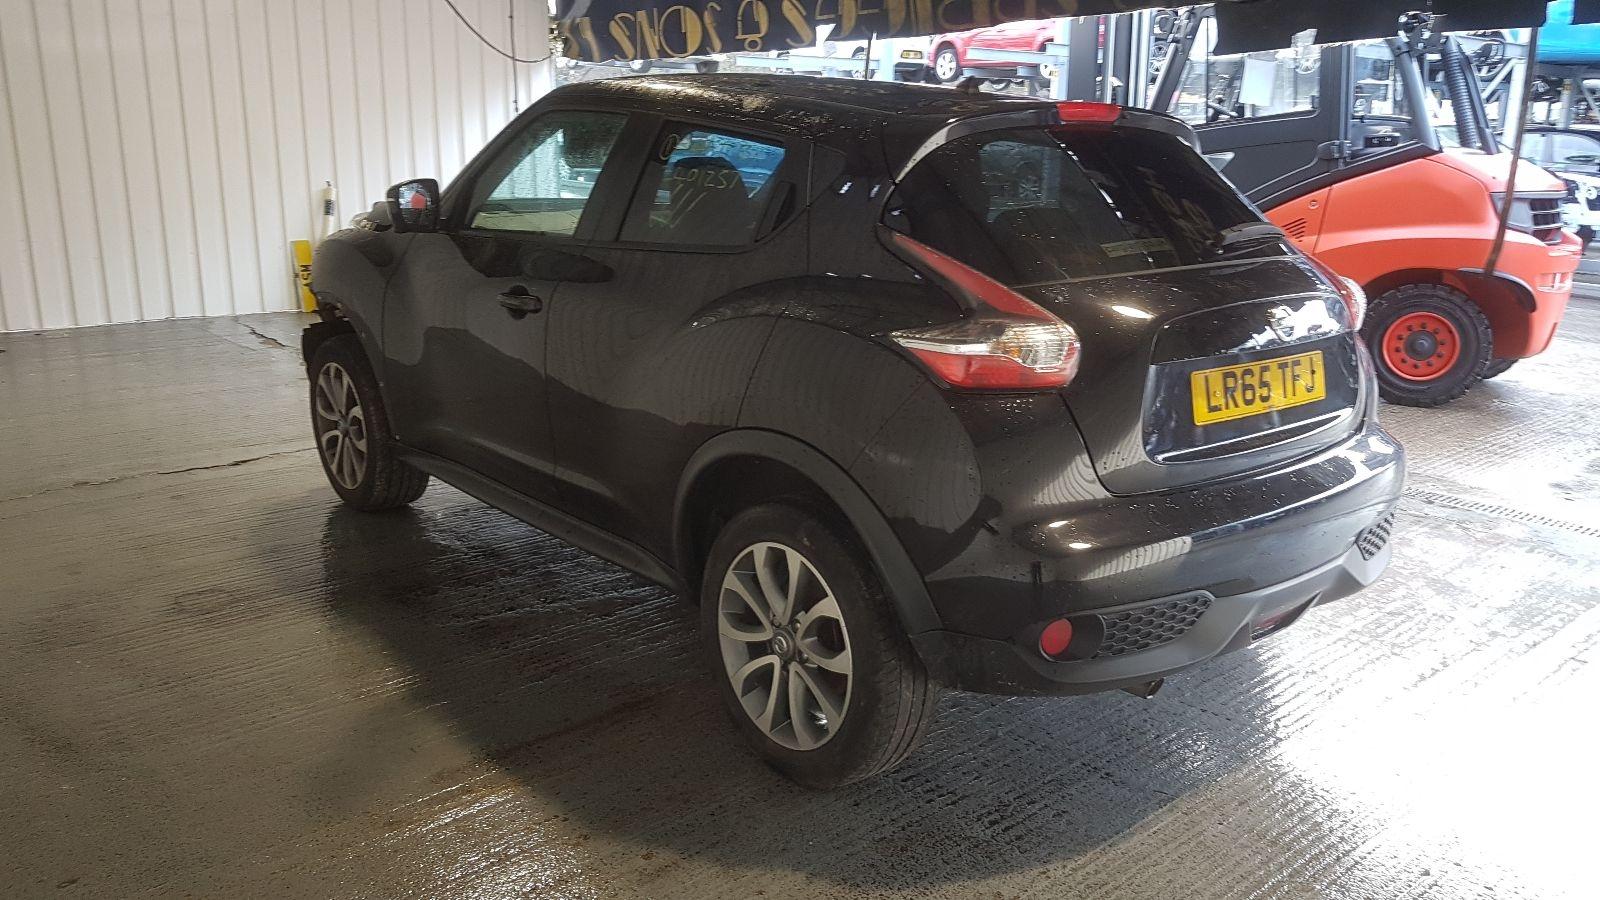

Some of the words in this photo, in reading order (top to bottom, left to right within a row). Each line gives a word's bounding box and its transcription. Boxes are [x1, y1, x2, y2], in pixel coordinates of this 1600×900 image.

[608, 1, 723, 61] SONS
[735, 0, 769, 51] &
[1204, 364, 1271, 414] LR65
[1278, 356, 1316, 399] TFJ
